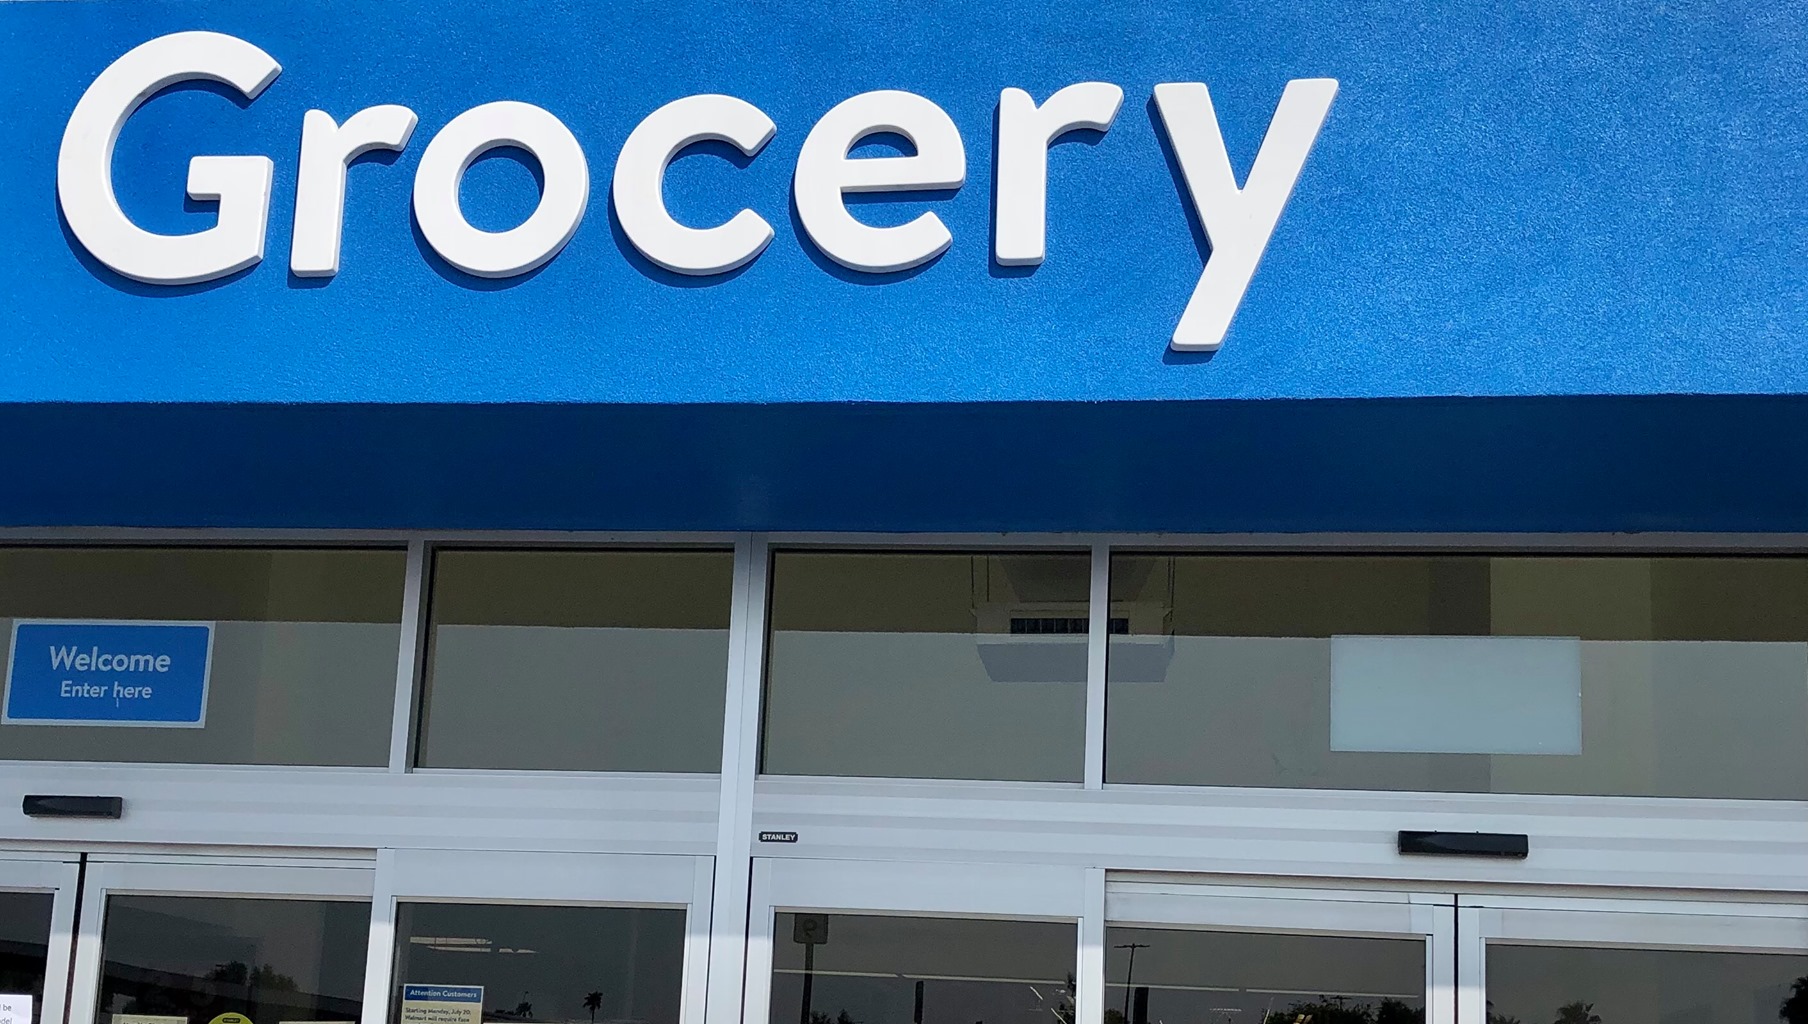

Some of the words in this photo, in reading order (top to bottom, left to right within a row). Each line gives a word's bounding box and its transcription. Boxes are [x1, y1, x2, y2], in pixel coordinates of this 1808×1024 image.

[57, 28, 1339, 355] Grocery
[50, 645, 171, 672] Welcome
[61, 680, 109, 698] Enter
[112, 681, 152, 699] here
[762, 833, 796, 841] STANLEY
[410, 989, 441, 997] Attention
[442, 990, 477, 998] Customers
[2, 1003, 12, 1012] be
